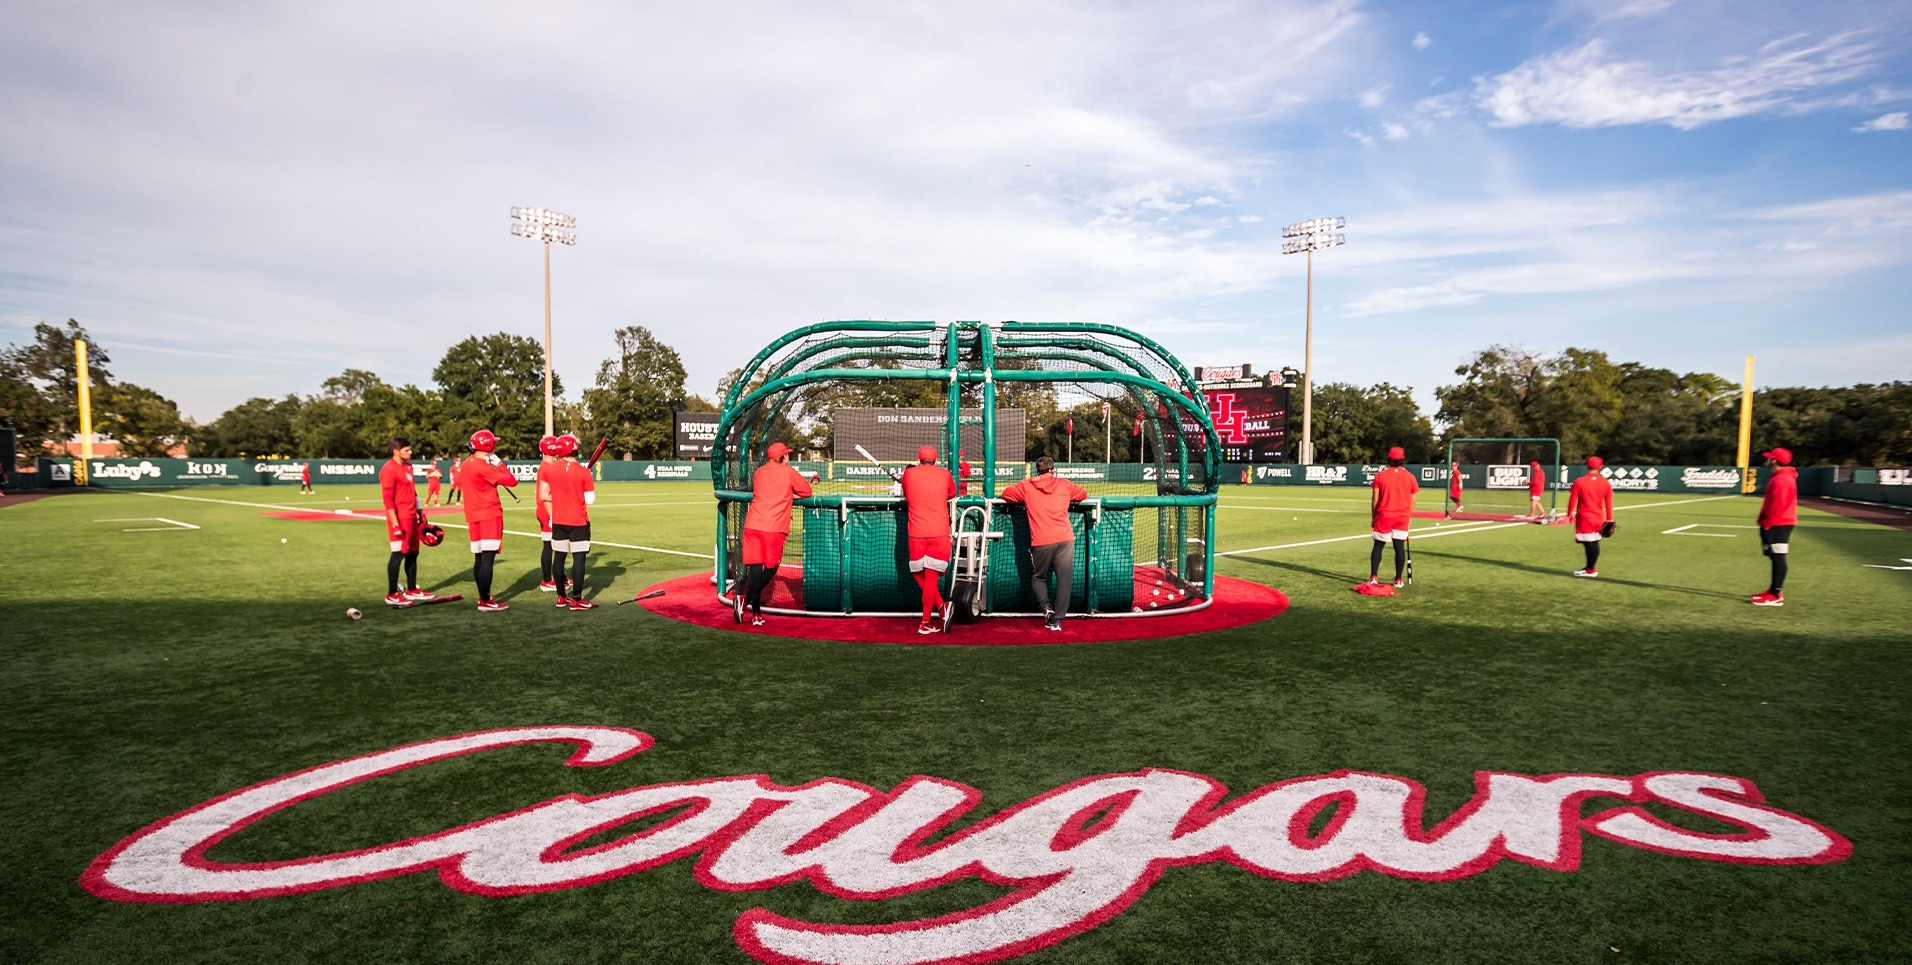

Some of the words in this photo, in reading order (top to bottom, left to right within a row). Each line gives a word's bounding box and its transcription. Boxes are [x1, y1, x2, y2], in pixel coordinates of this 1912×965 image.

[1201, 366, 1241, 383] Cougars
[877, 415, 898, 423] DON
[92, 461, 161, 481] Luby's
[320, 464, 375, 475] NISSAN
[644, 464, 656, 479] 4
[845, 467, 887, 475] DARRYL
[1268, 468, 1292, 477] POWELL
[1494, 467, 1523, 477] BUD
[1489, 476, 1529, 486] LIGHT
[1680, 467, 1740, 484] Freddy's
[80, 726, 1854, 965] Cougars
